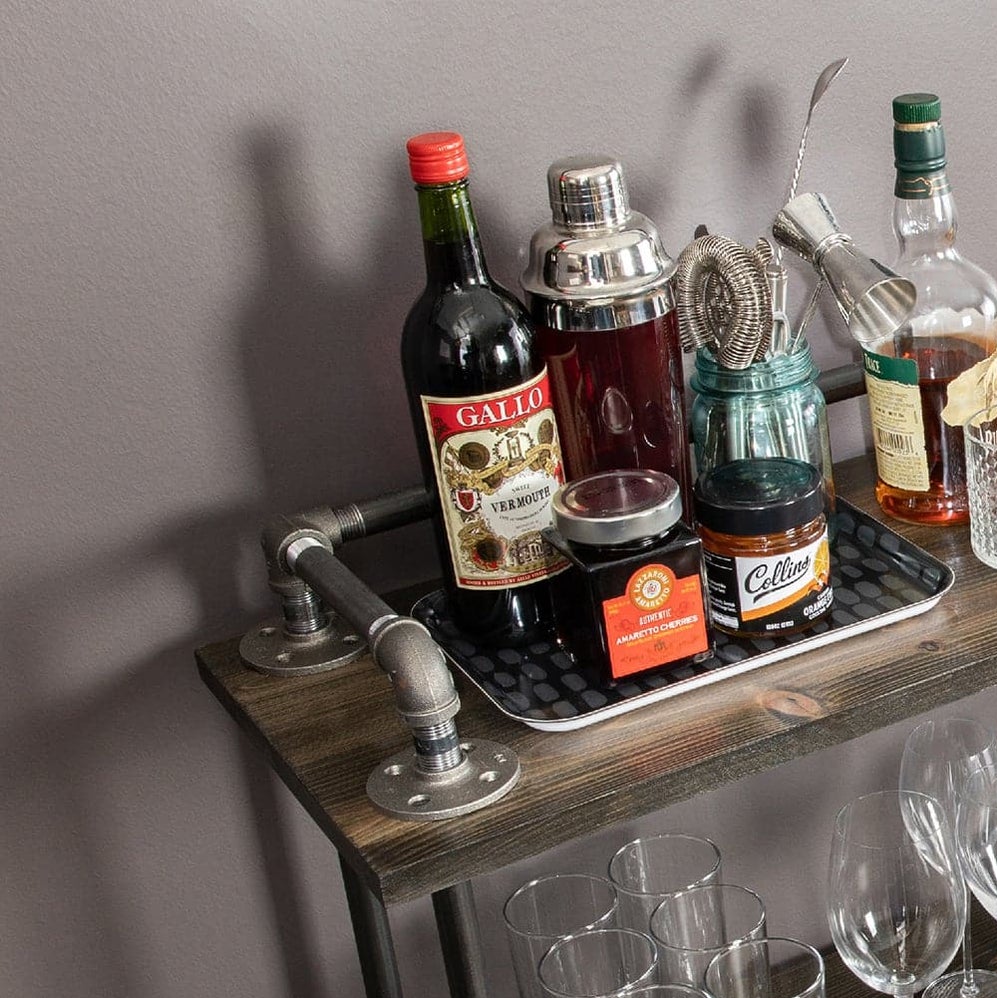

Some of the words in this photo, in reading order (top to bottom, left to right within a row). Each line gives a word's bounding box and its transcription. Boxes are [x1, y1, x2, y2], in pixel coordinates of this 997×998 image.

[456, 387, 543, 428] GALLO
[491, 486, 551, 514] VERMOUTH
[633, 570, 670, 593] LAZZARONI
[744, 556, 812, 594] Collins
[635, 587, 671, 608] AMARETTO
[615, 625, 660, 646] AMARETTO
[659, 613, 700, 633] CHERRIES
[639, 607, 673, 626] AUTHENTIC
